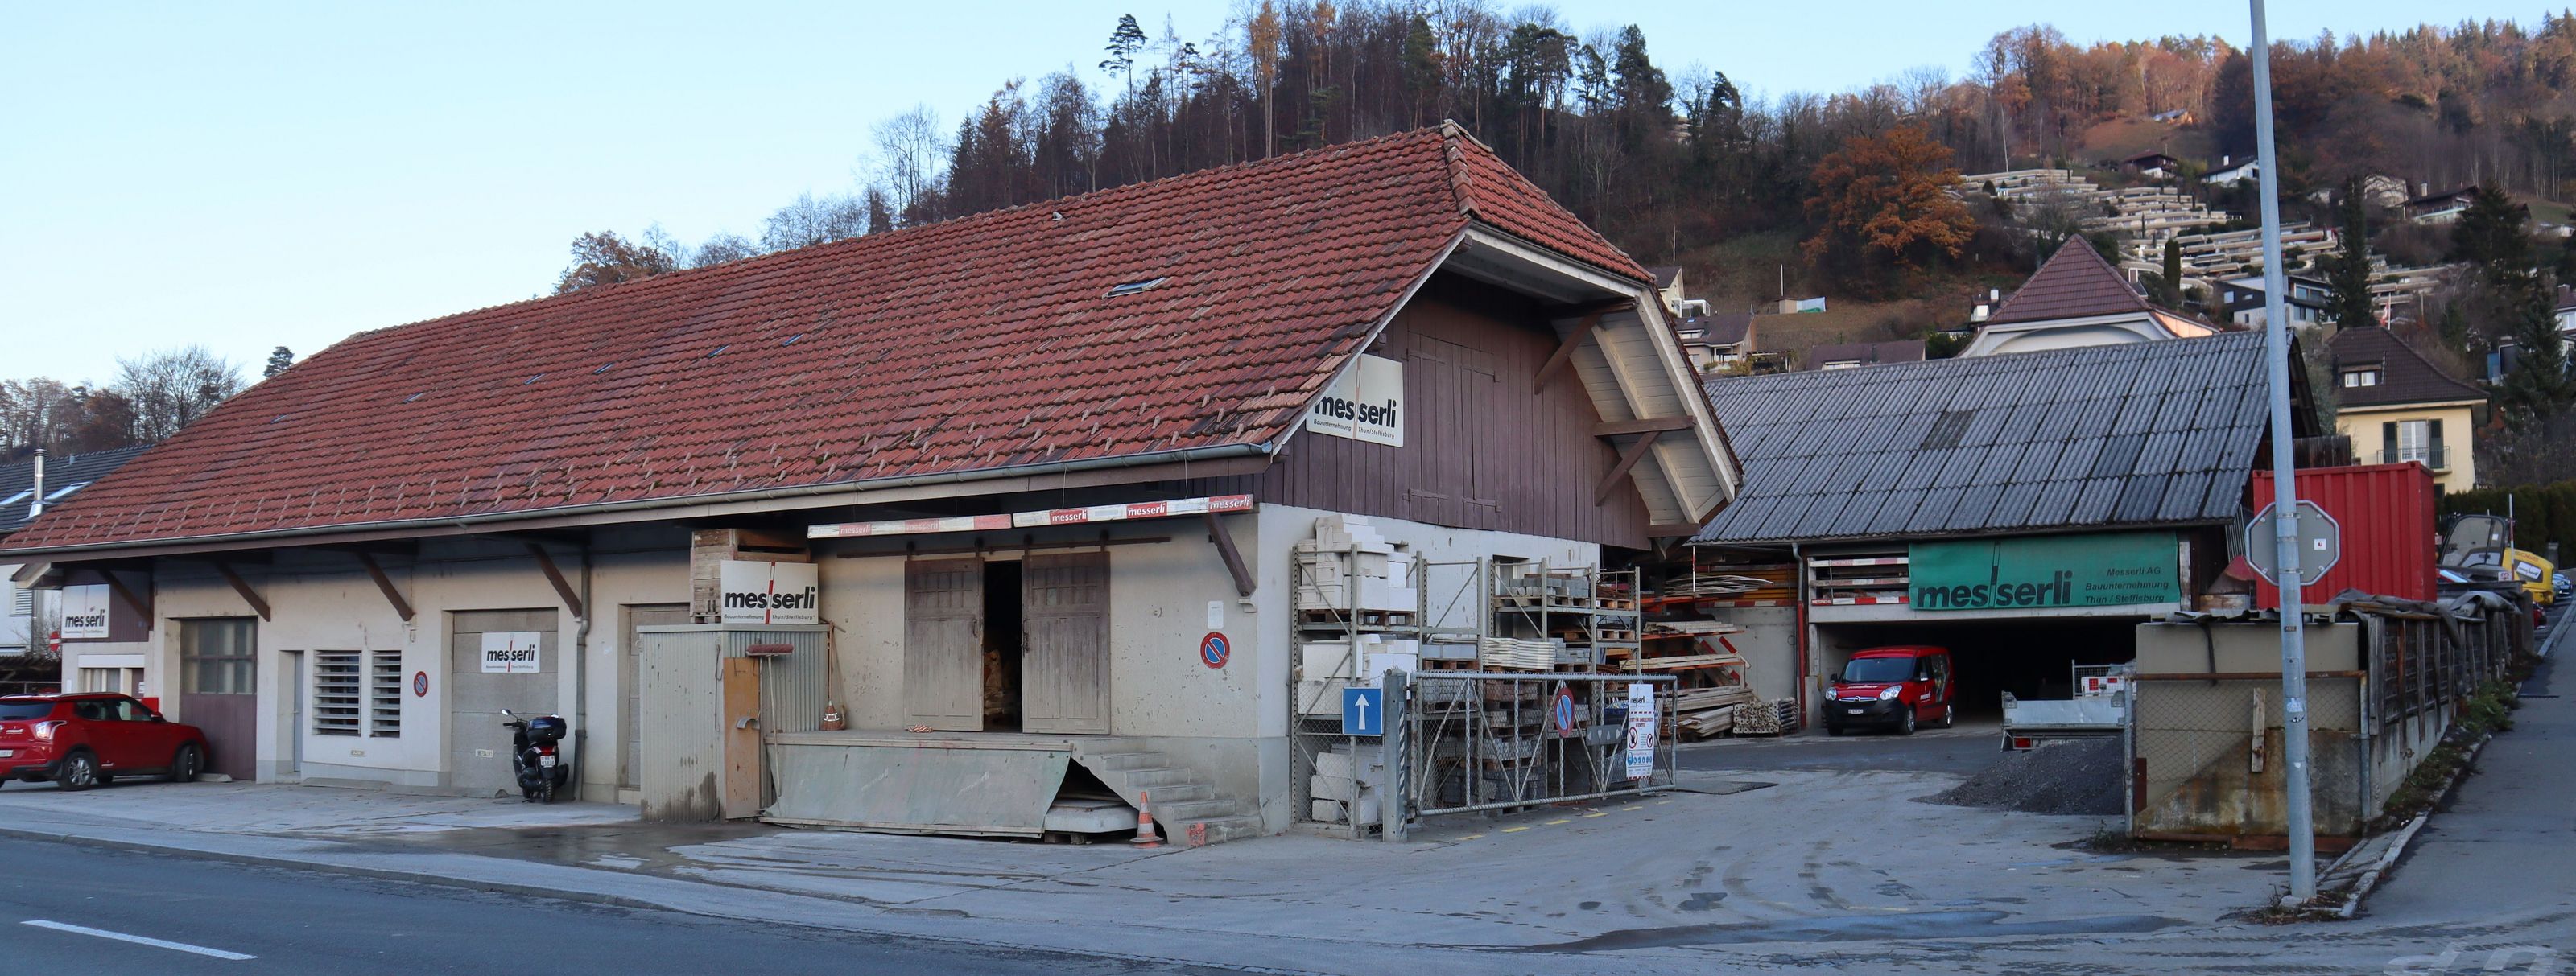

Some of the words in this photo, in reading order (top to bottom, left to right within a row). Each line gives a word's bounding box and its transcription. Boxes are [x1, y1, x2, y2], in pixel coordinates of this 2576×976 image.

[1315, 396, 1397, 428] messerli
[1313, 418, 1352, 432] Bauunternehmung
[1127, 501, 1166, 517] messerli
[1210, 495, 1251, 509] messerli
[1051, 509, 1088, 523] messerli
[840, 523, 872, 535] messerli
[906, 518, 939, 532] messerli
[2107, 566, 2145, 577] Messerli
[2146, 566, 2161, 575] AG
[1917, 570, 2074, 608] messerli
[2085, 581, 2169, 591] Bauunternehmung
[724, 586, 816, 609] messerli
[2085, 595, 2107, 603] Thun
[2116, 594, 2165, 603] Steffisburg
[64, 608, 105, 628] messerli
[486, 644, 535, 661] messerli
